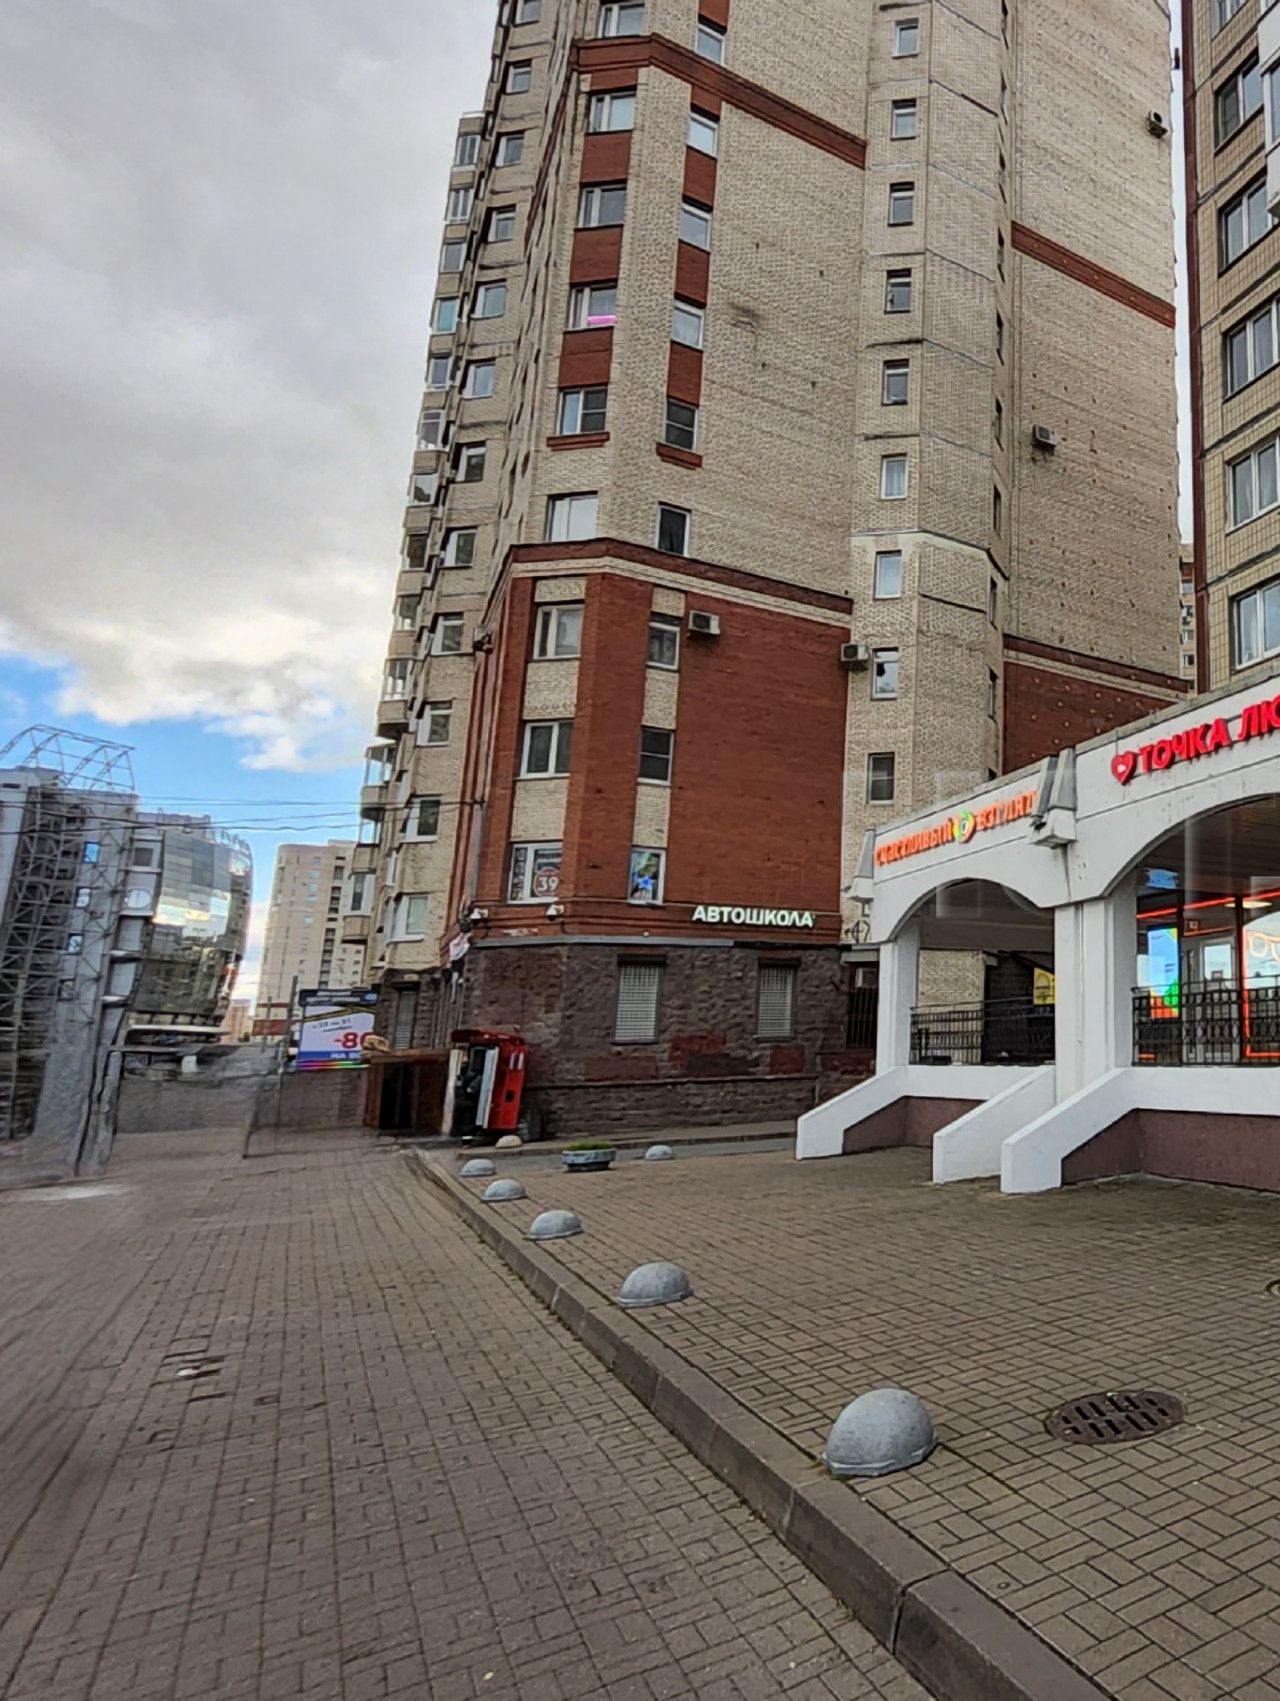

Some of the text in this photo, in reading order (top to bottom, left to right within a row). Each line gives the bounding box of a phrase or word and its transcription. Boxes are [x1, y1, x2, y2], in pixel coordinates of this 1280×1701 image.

[1139, 718, 1232, 773] ТОЧКА
[538, 876, 559, 892] 39
[691, 905, 814, 928] АВТОШКОЛА
